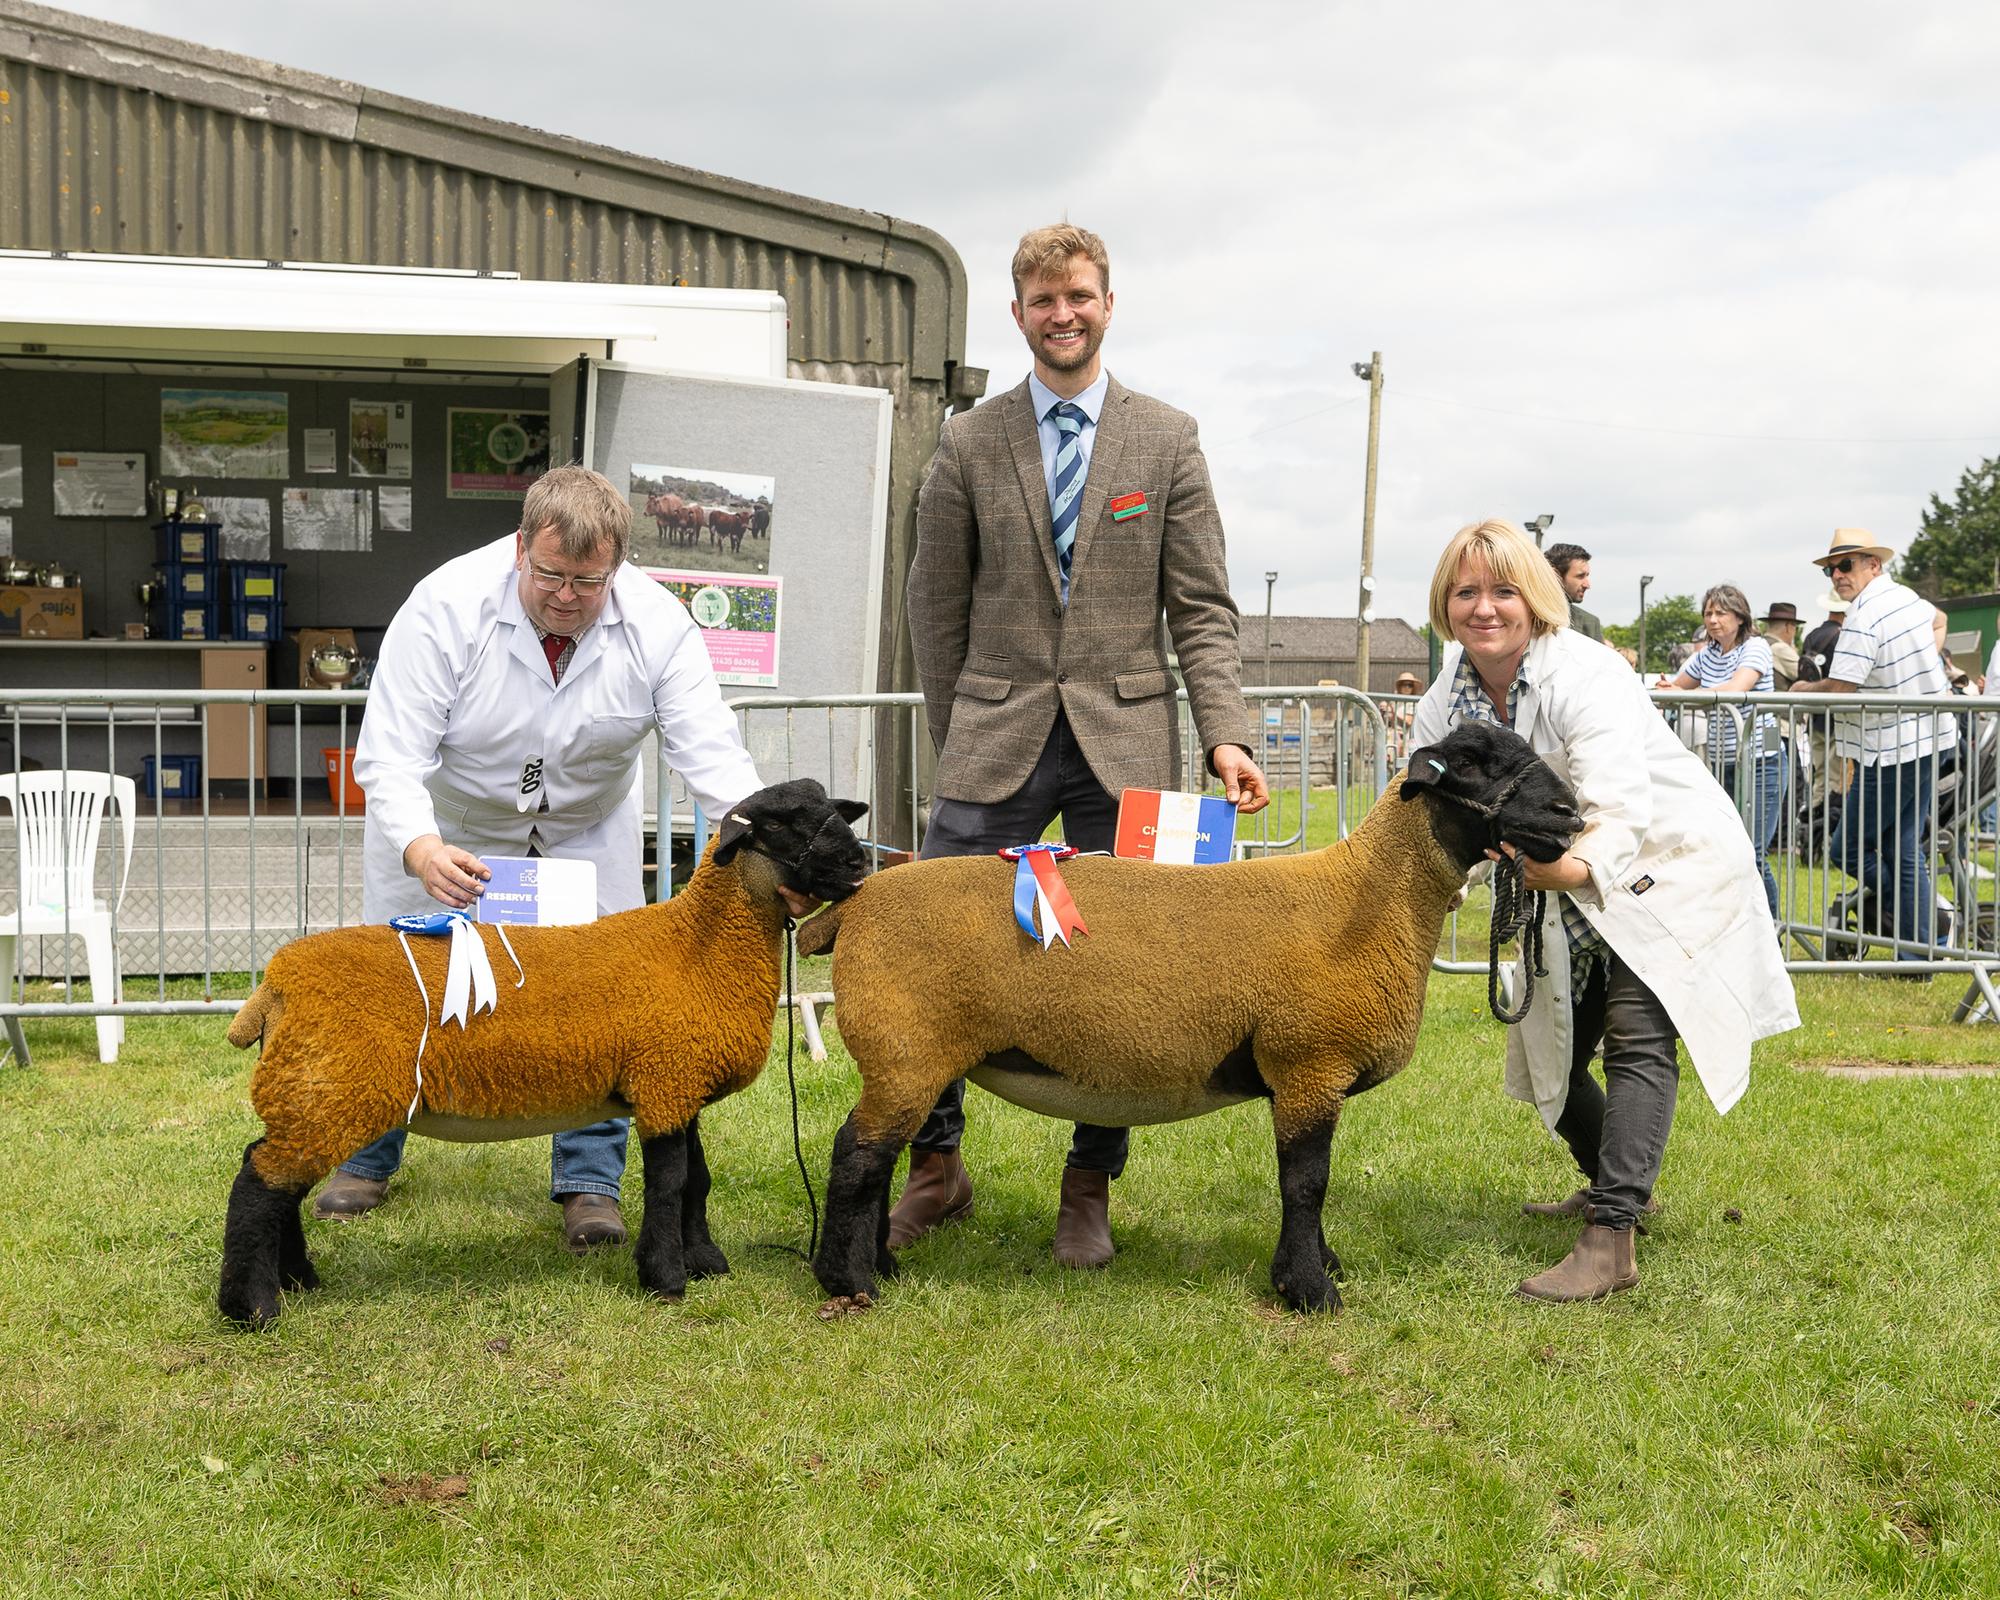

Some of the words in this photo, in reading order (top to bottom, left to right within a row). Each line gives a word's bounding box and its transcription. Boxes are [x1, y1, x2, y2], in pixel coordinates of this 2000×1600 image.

[352, 439, 410, 450] Meadows
[520, 757, 544, 795] 260
[486, 892, 532, 902] RESERVE
